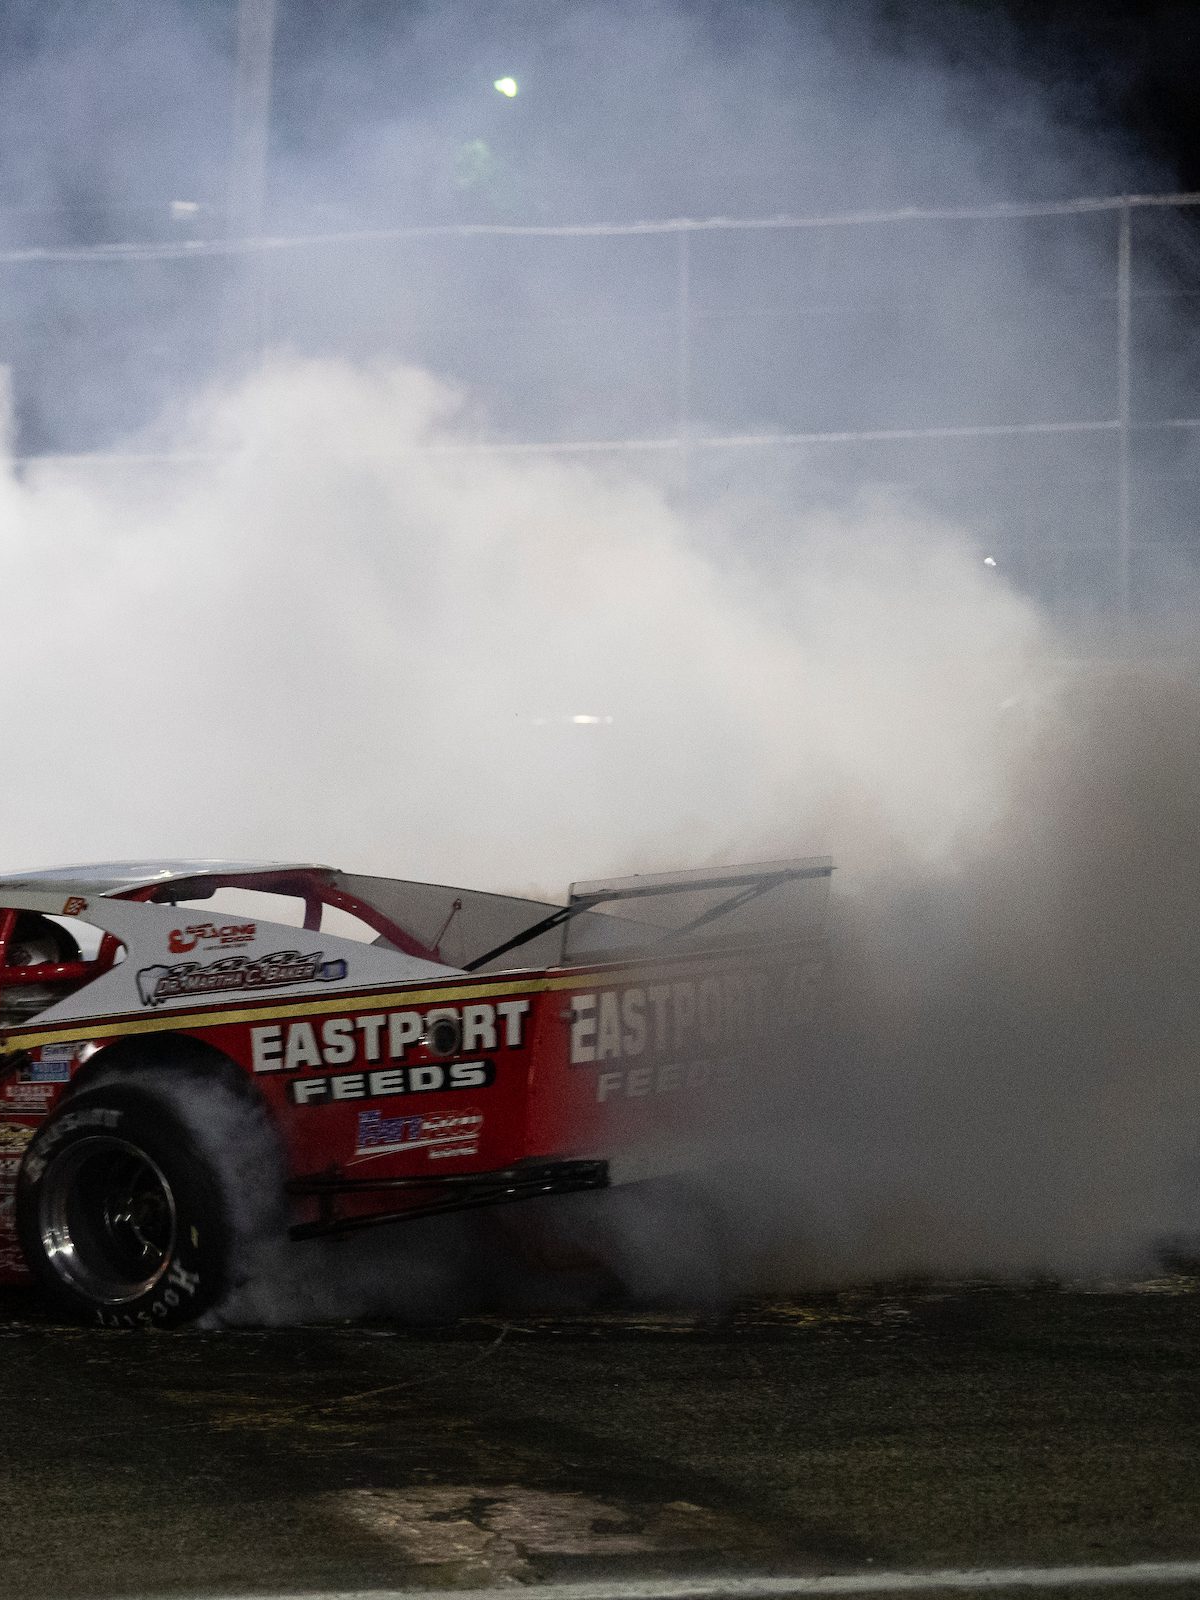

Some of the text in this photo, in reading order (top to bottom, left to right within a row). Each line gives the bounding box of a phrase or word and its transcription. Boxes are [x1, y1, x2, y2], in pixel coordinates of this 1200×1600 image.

[186, 970, 241, 990] MARTHA
[265, 963, 314, 981] BAKER
[293, 1061, 487, 1104] FEEDS
